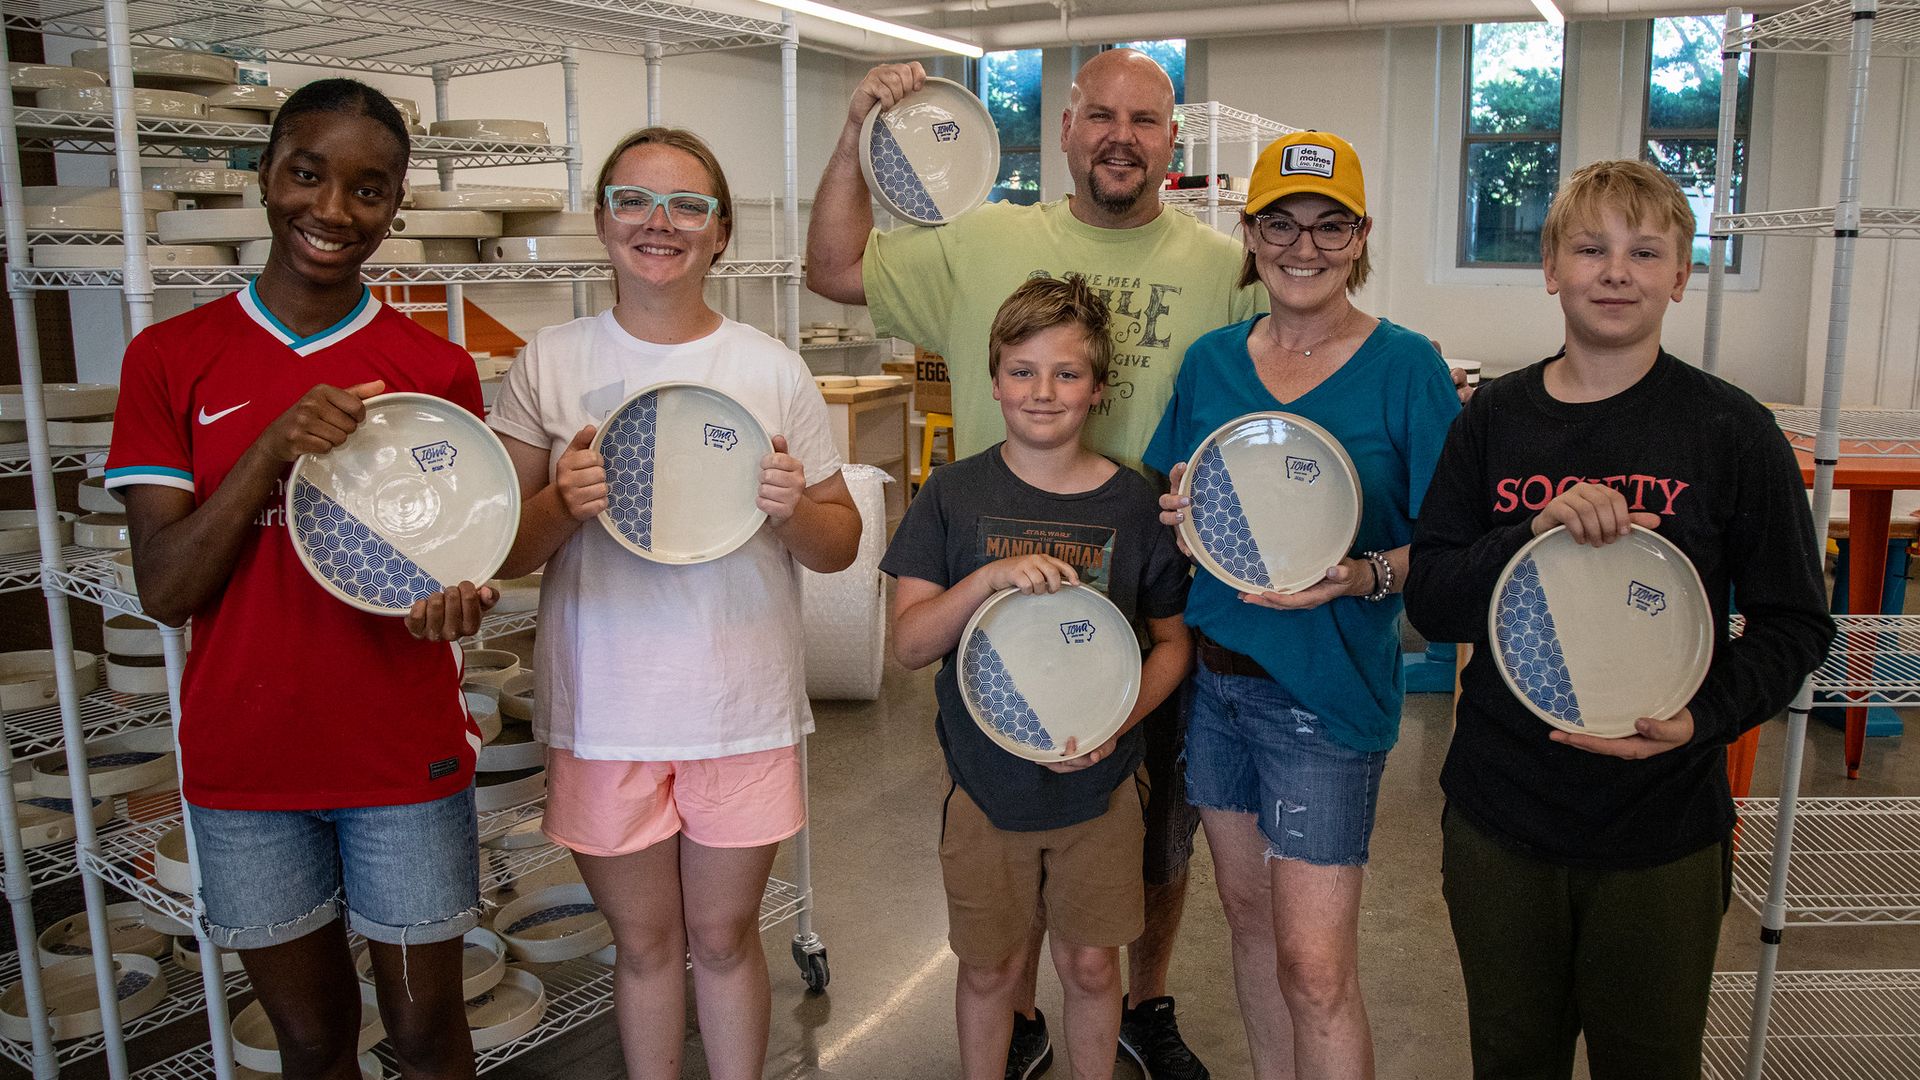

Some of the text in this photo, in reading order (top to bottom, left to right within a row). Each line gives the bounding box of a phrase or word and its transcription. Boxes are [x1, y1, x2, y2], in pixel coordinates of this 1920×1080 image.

[1300, 155, 1331, 165] moines
[1107, 276, 1130, 288] ME
[1131, 278, 1141, 288] A
[1112, 353, 1151, 368] GIVE
